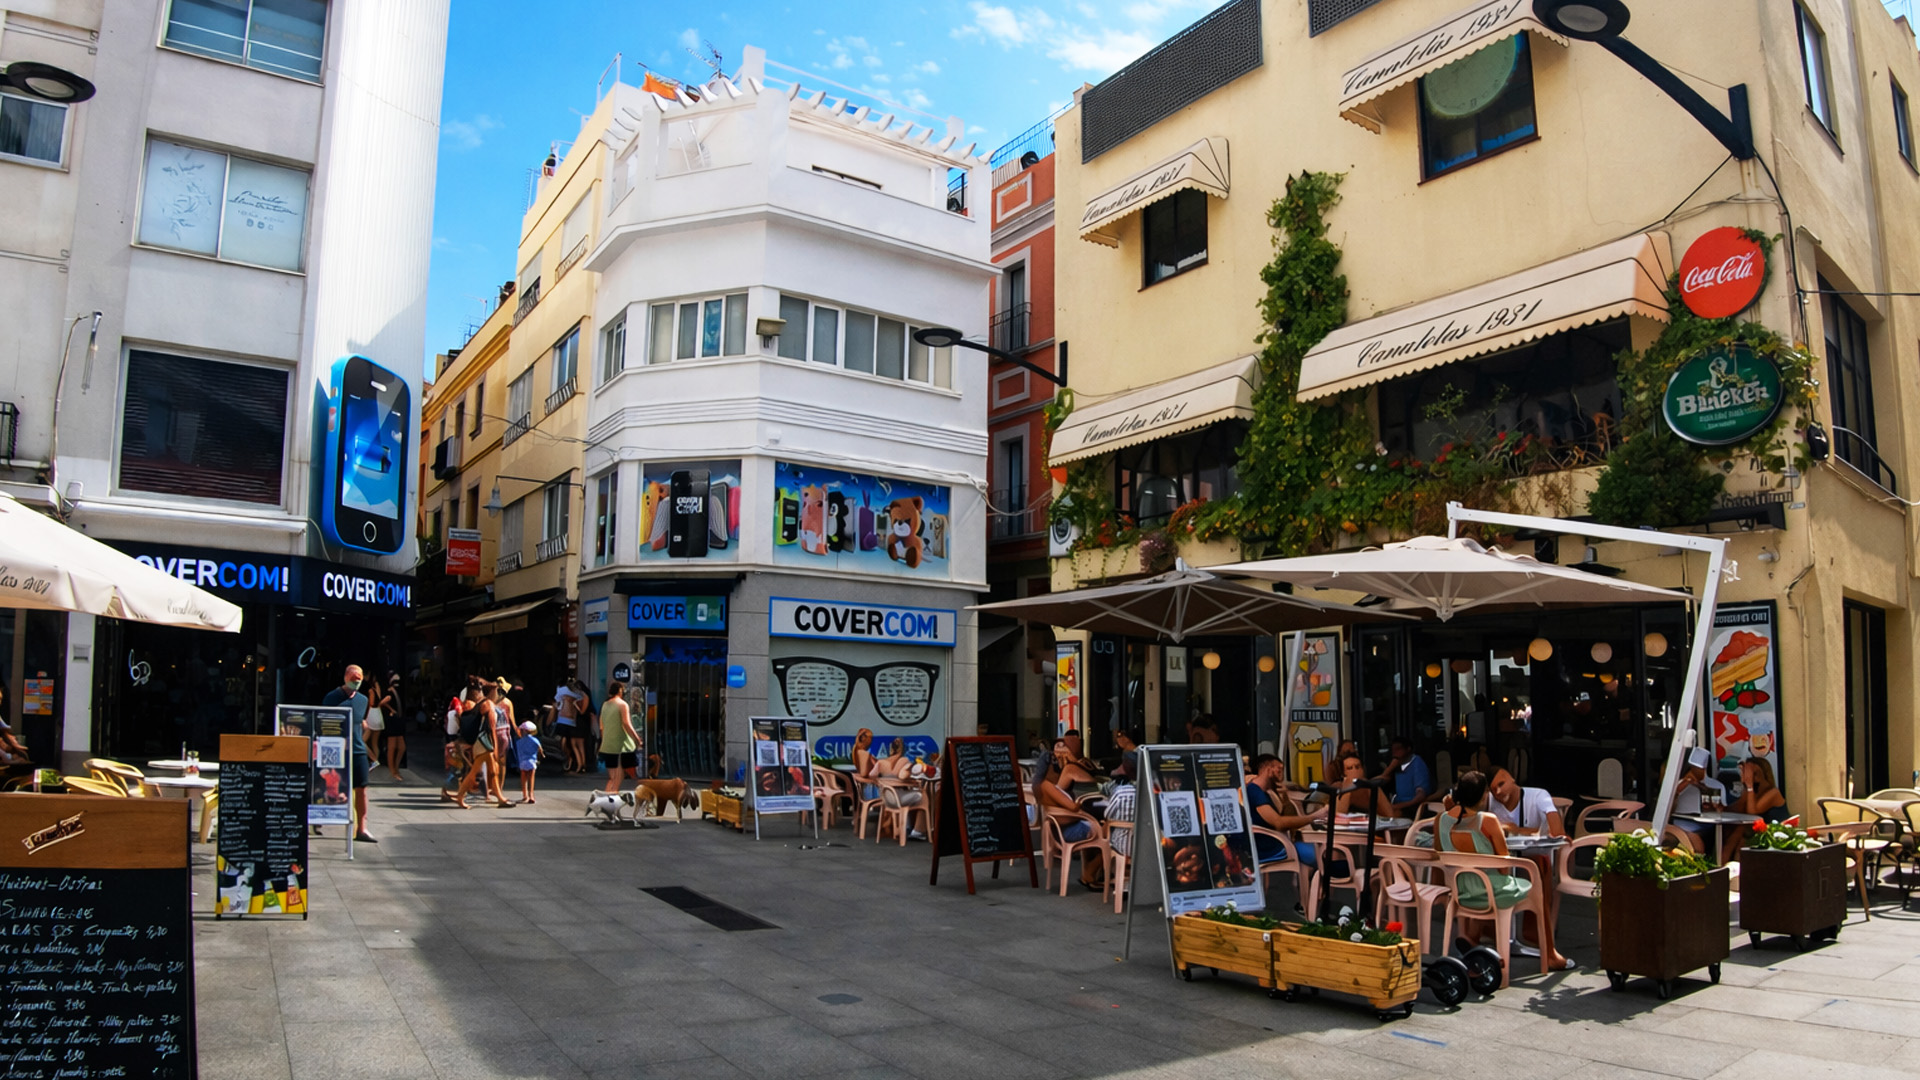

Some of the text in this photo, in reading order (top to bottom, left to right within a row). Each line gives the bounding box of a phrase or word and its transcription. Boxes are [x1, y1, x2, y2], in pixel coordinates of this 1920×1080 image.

[323, 571, 411, 608] COVERCOM!
[631, 602, 686, 621] COVER
[794, 604, 938, 639] COVERCOM!
